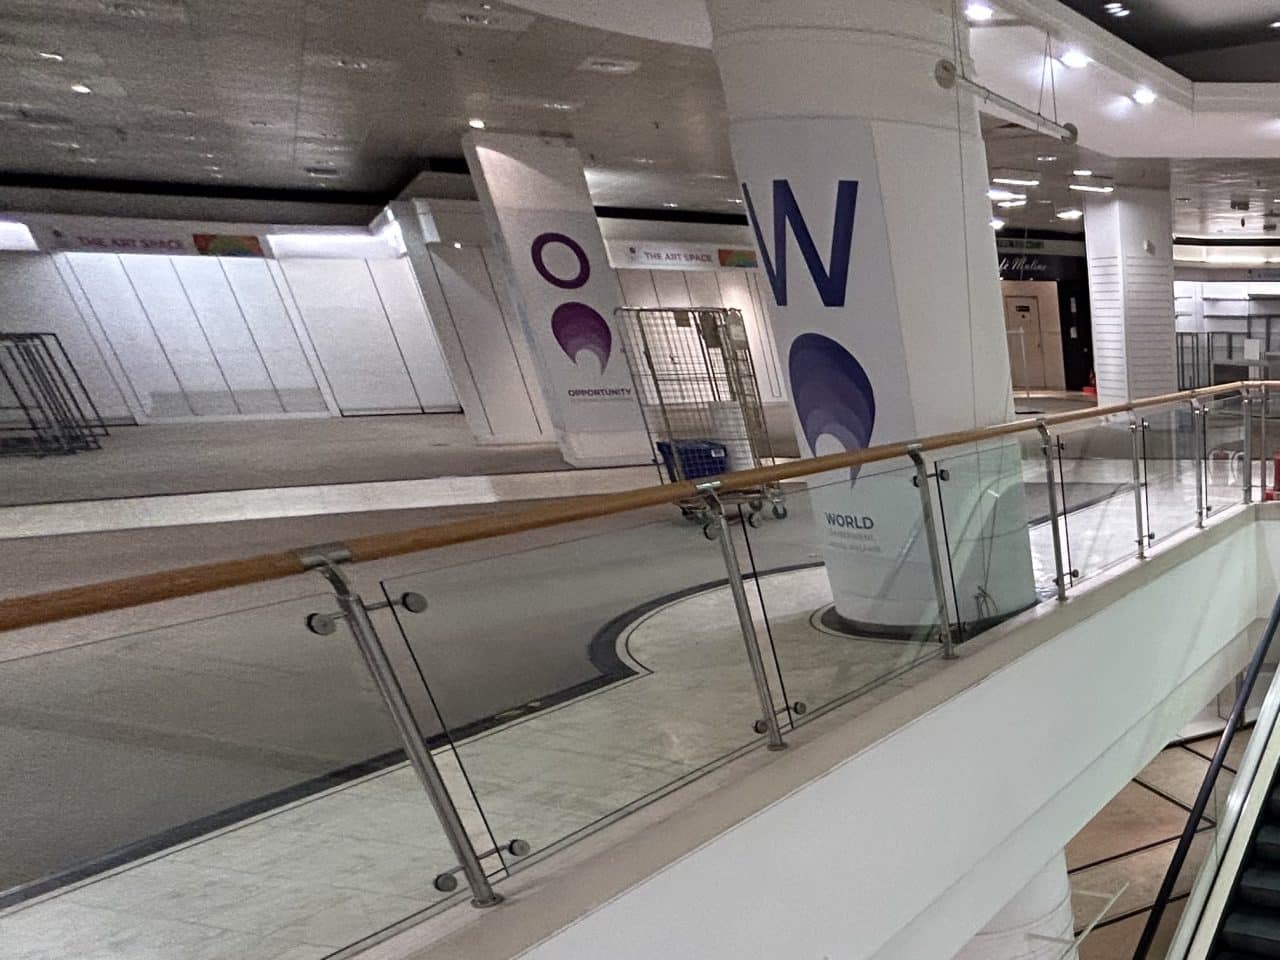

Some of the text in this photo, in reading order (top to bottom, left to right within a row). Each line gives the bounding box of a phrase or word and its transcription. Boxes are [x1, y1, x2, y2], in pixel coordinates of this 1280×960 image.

[742, 179, 859, 307] W
[531, 232, 591, 290] O
[665, 253, 682, 261] ART
[685, 254, 713, 262] SPACE
[567, 388, 631, 397] OPPORTUNITY
[825, 512, 874, 530] WORLD
